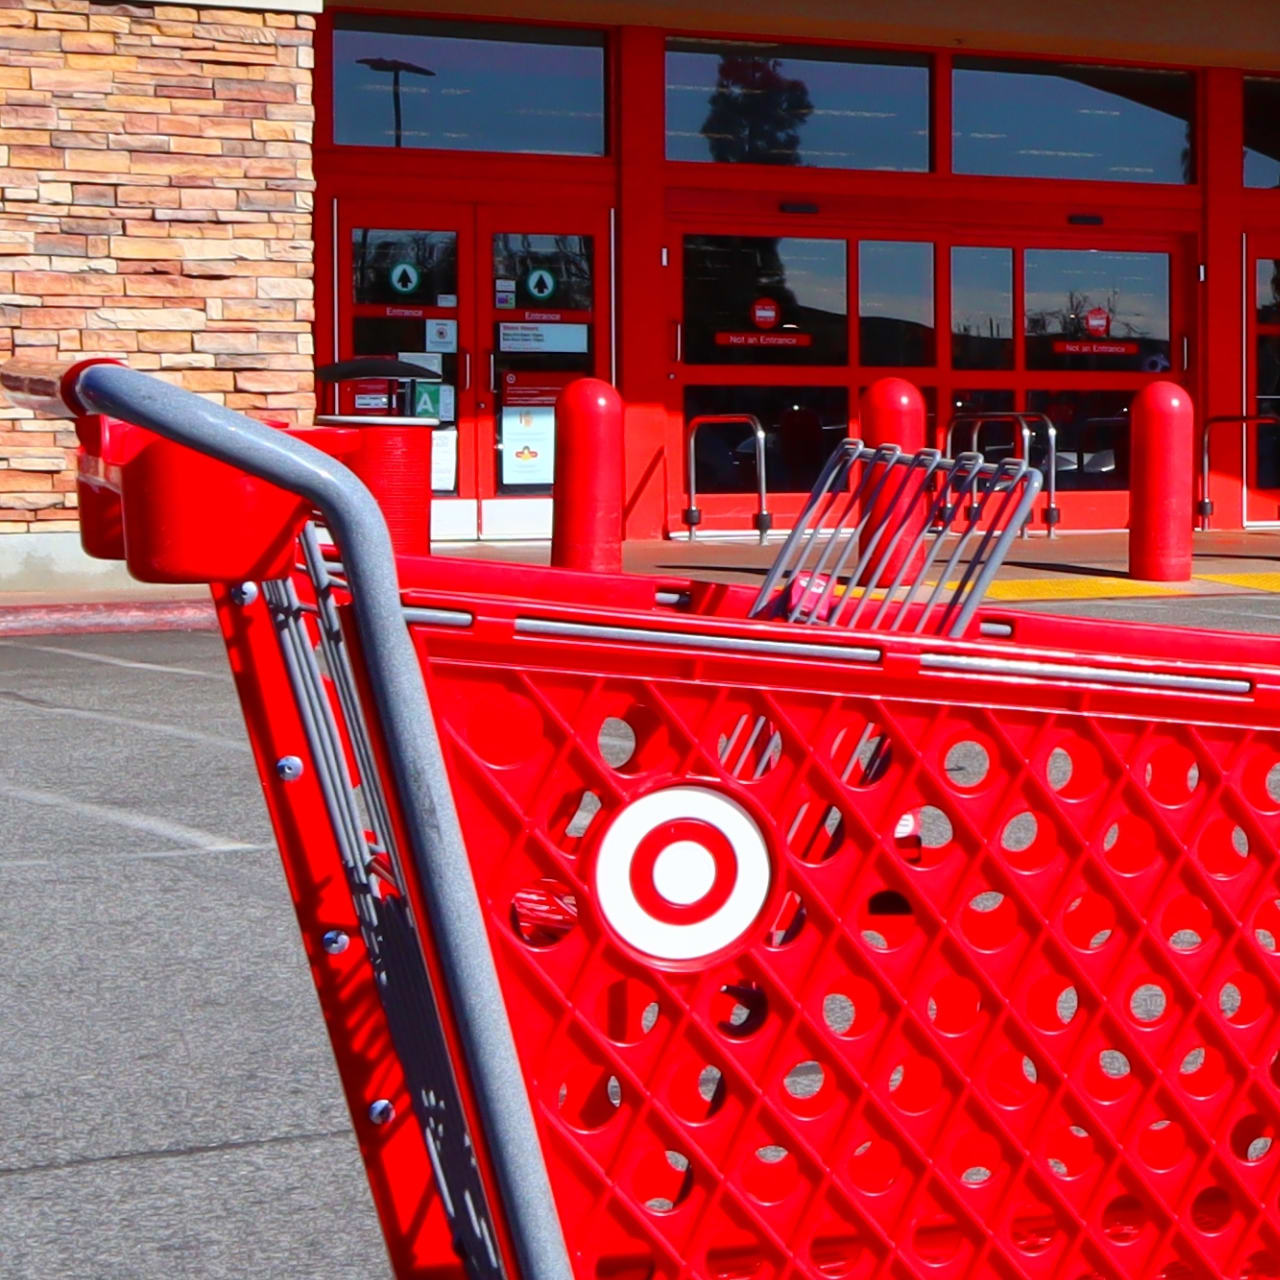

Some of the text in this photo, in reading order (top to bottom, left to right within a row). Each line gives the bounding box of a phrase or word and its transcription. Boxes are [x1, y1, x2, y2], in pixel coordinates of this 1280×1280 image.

[730, 336, 745, 344] Not
[760, 336, 797, 345] Entrance
[1066, 344, 1079, 352] Not
[1093, 345, 1125, 353] Entrance
[417, 393, 434, 413] A
